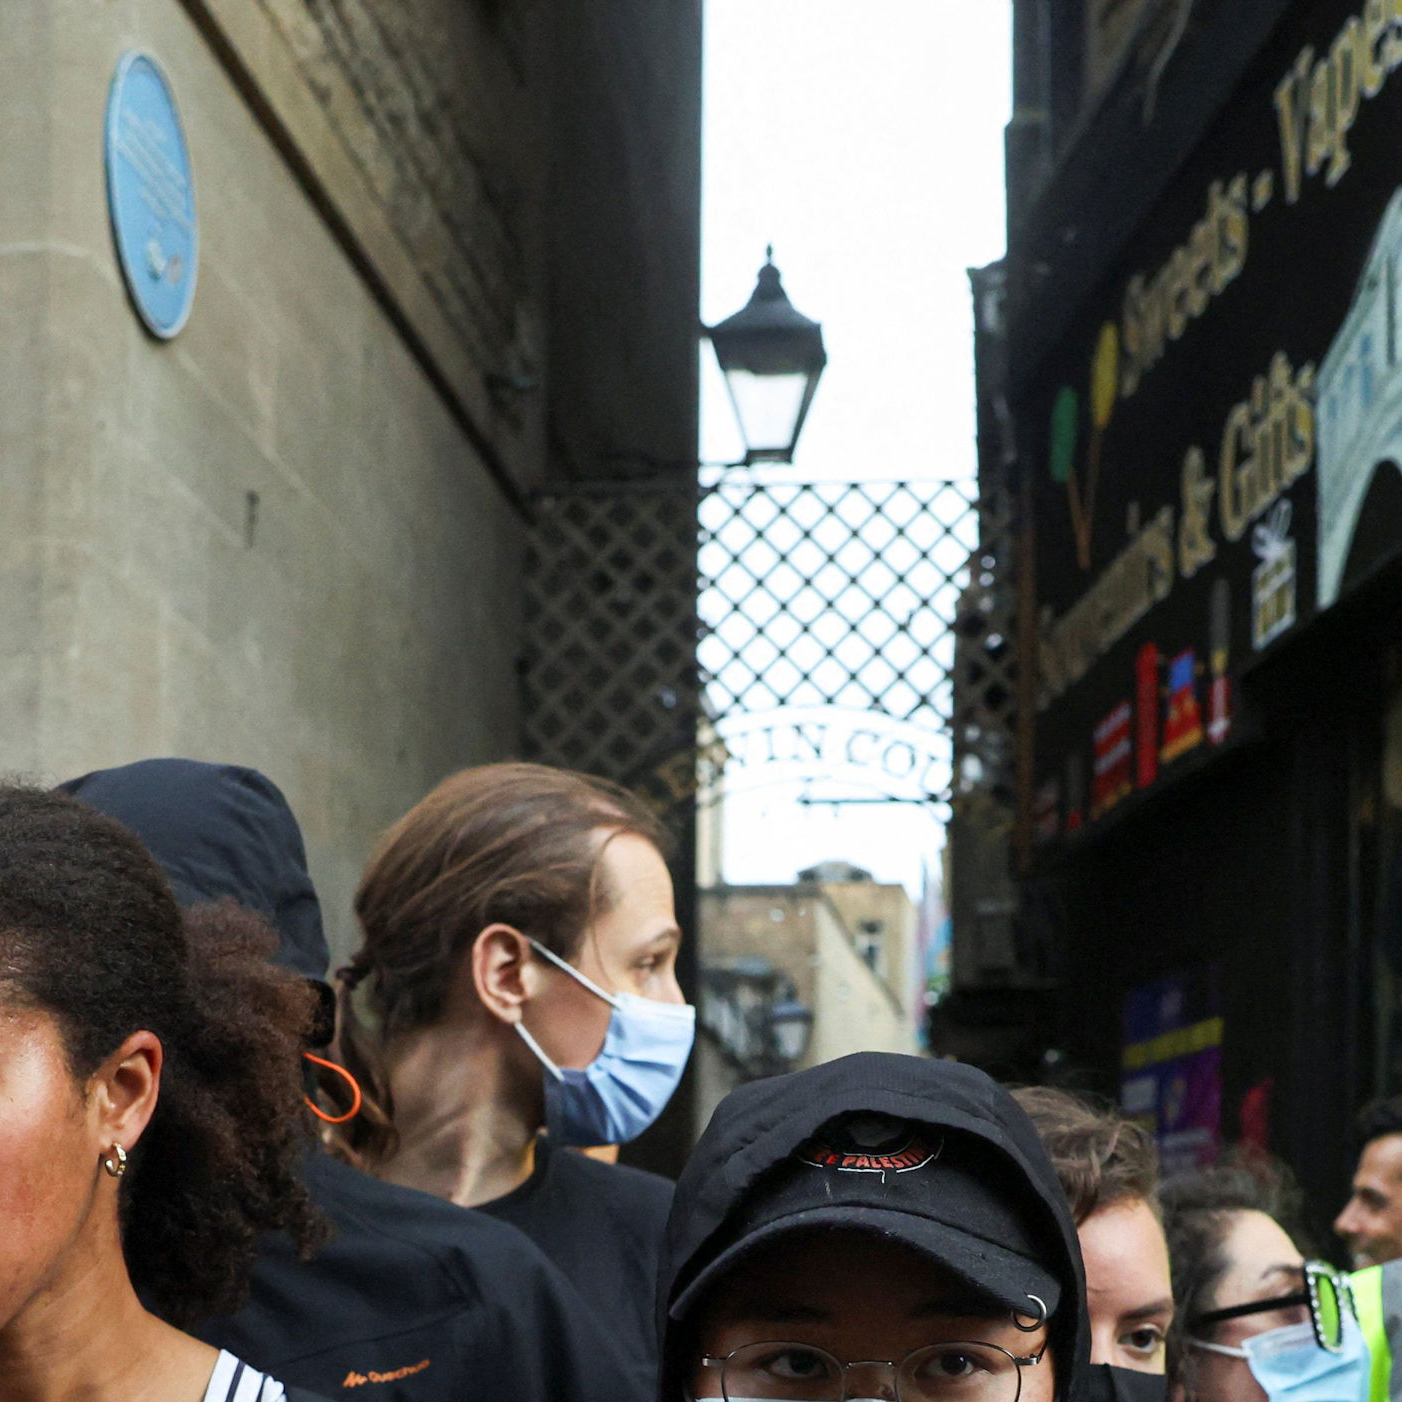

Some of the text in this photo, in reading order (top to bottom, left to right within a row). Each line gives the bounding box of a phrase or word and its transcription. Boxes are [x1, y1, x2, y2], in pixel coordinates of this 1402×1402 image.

[1121, 172, 1250, 398] Sweets
[1179, 445, 1217, 579] &
[1218, 351, 1316, 542] Gifts
